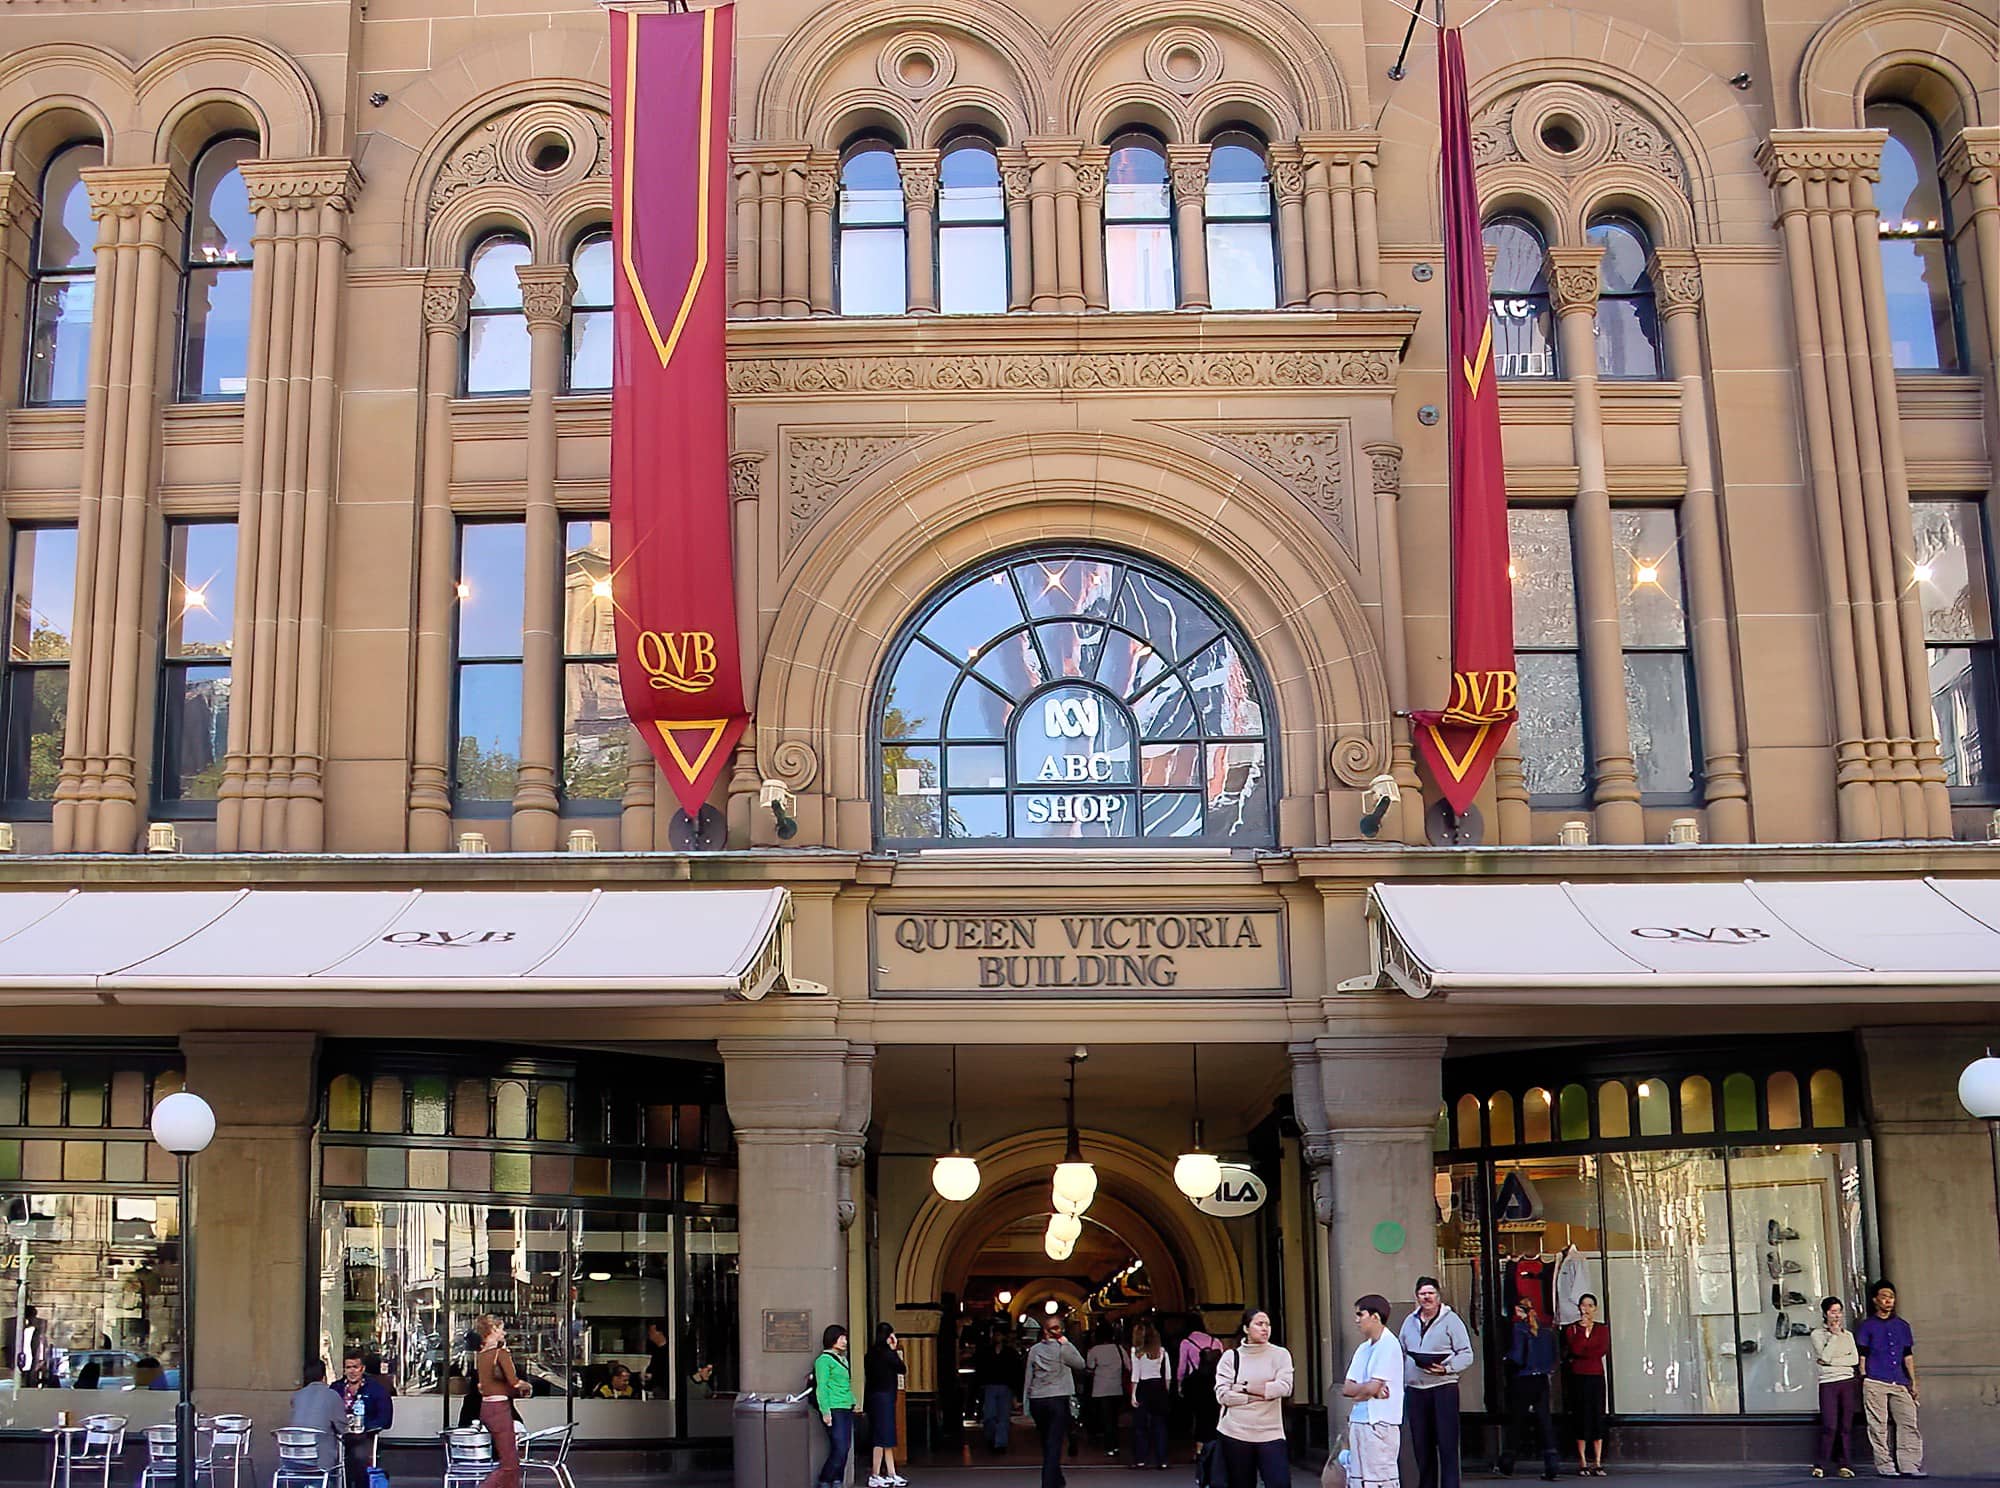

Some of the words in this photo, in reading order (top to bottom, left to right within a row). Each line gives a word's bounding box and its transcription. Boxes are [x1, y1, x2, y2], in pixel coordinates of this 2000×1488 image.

[637, 630, 717, 693] QVB
[1037, 752, 1112, 782] ABC
[1027, 795, 1121, 823] SHOP
[382, 931, 516, 947] QVB
[895, 918, 1035, 953] QUEEN
[1061, 915, 1262, 949] VICTORIA
[1630, 927, 1771, 944] QVB
[977, 955, 1177, 988] BUILDING
